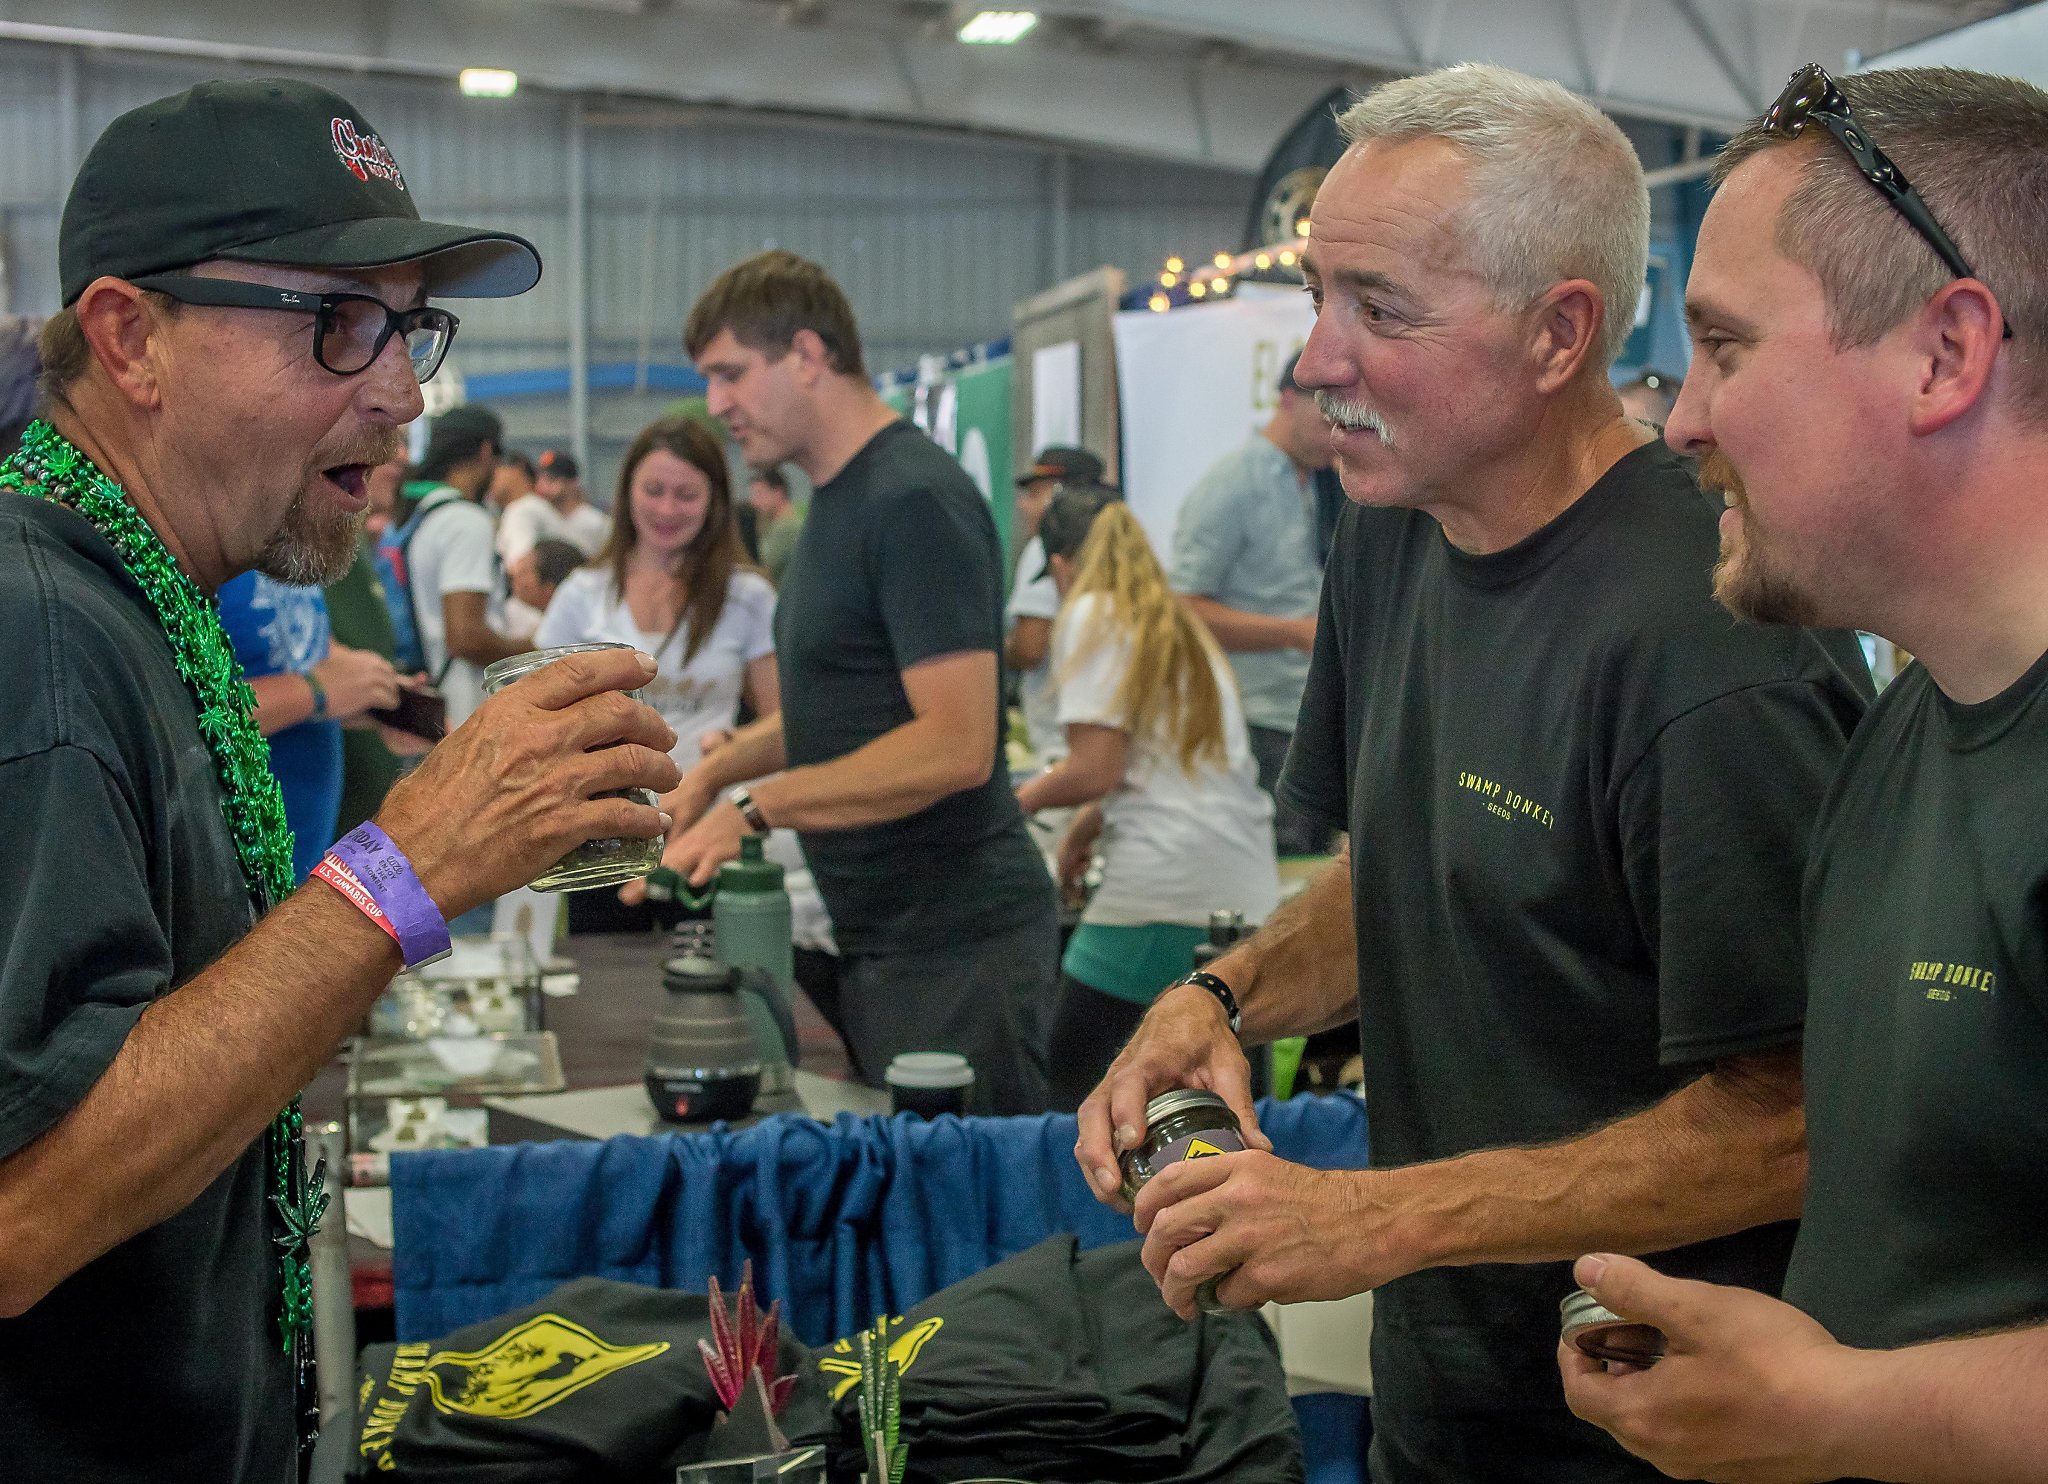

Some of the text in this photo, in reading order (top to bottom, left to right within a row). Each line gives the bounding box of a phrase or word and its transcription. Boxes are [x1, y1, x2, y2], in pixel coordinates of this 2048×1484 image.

[1459, 771, 1555, 830] SWAMP DONKEY
[1487, 802, 1511, 820] SEEDS
[363, 864, 388, 893] MOMENT
[375, 867, 388, 880] THE
[379, 859, 397, 880] ENJOY
[319, 865, 333, 878] U.S.
[332, 875, 368, 905] CANNABIS
[365, 902, 383, 917] CUP
